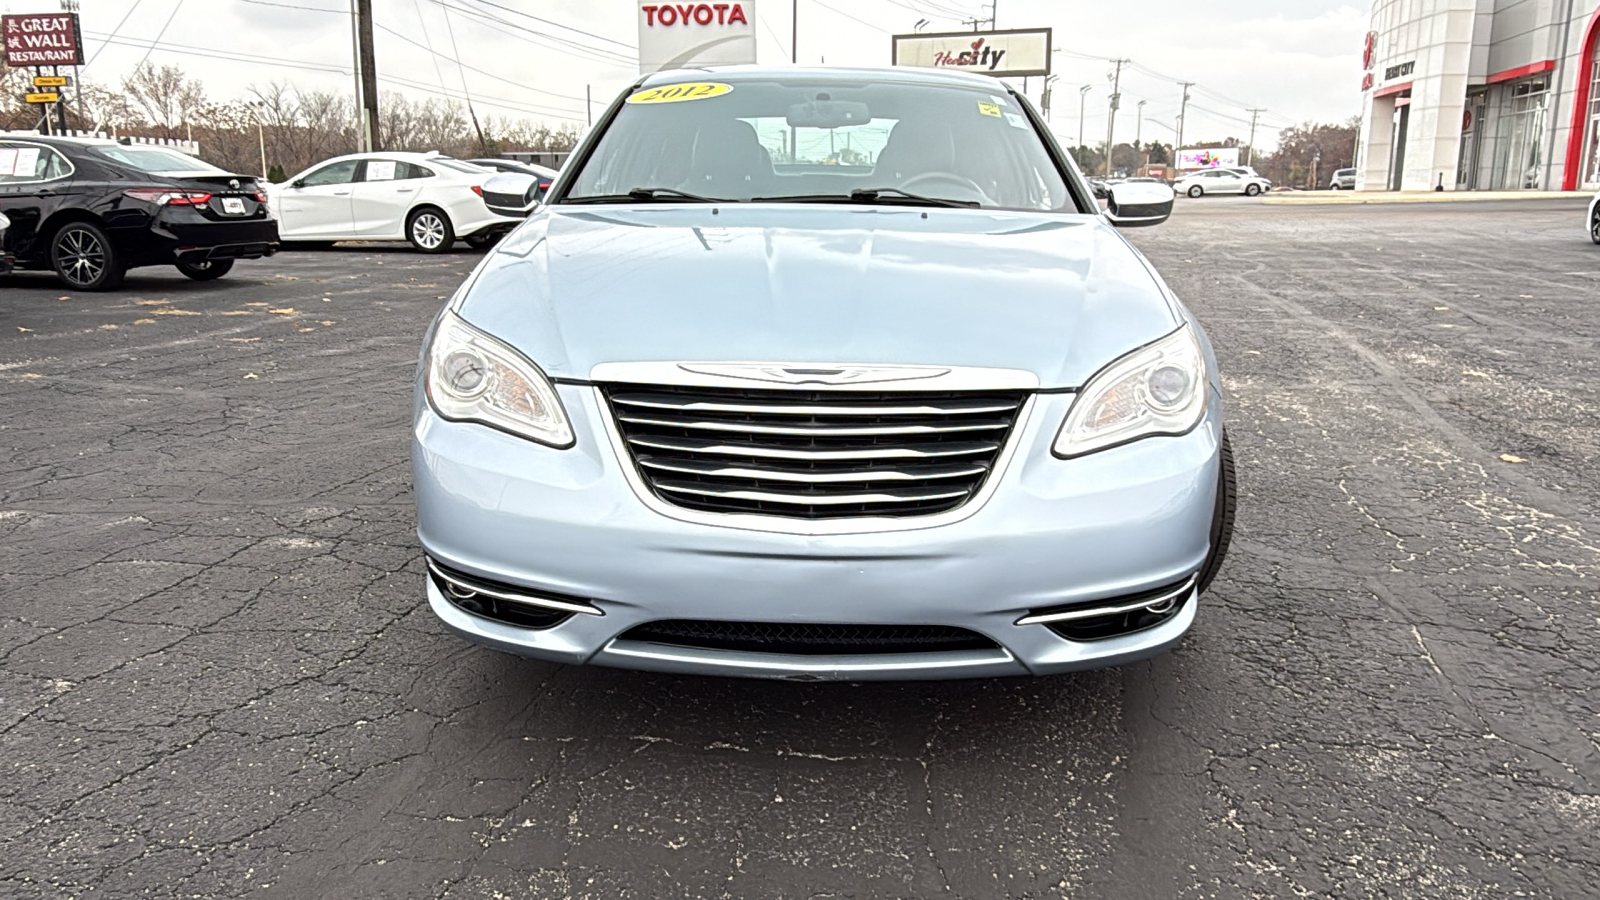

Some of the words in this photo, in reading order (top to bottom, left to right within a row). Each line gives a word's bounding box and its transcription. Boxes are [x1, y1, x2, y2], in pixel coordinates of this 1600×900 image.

[642, 4, 747, 26] TOYOTA
[21, 17, 69, 32] GREAT
[23, 34, 71, 48] WALL
[8, 49, 75, 62] RESTAURANT
[643, 85, 716, 101] 2012
